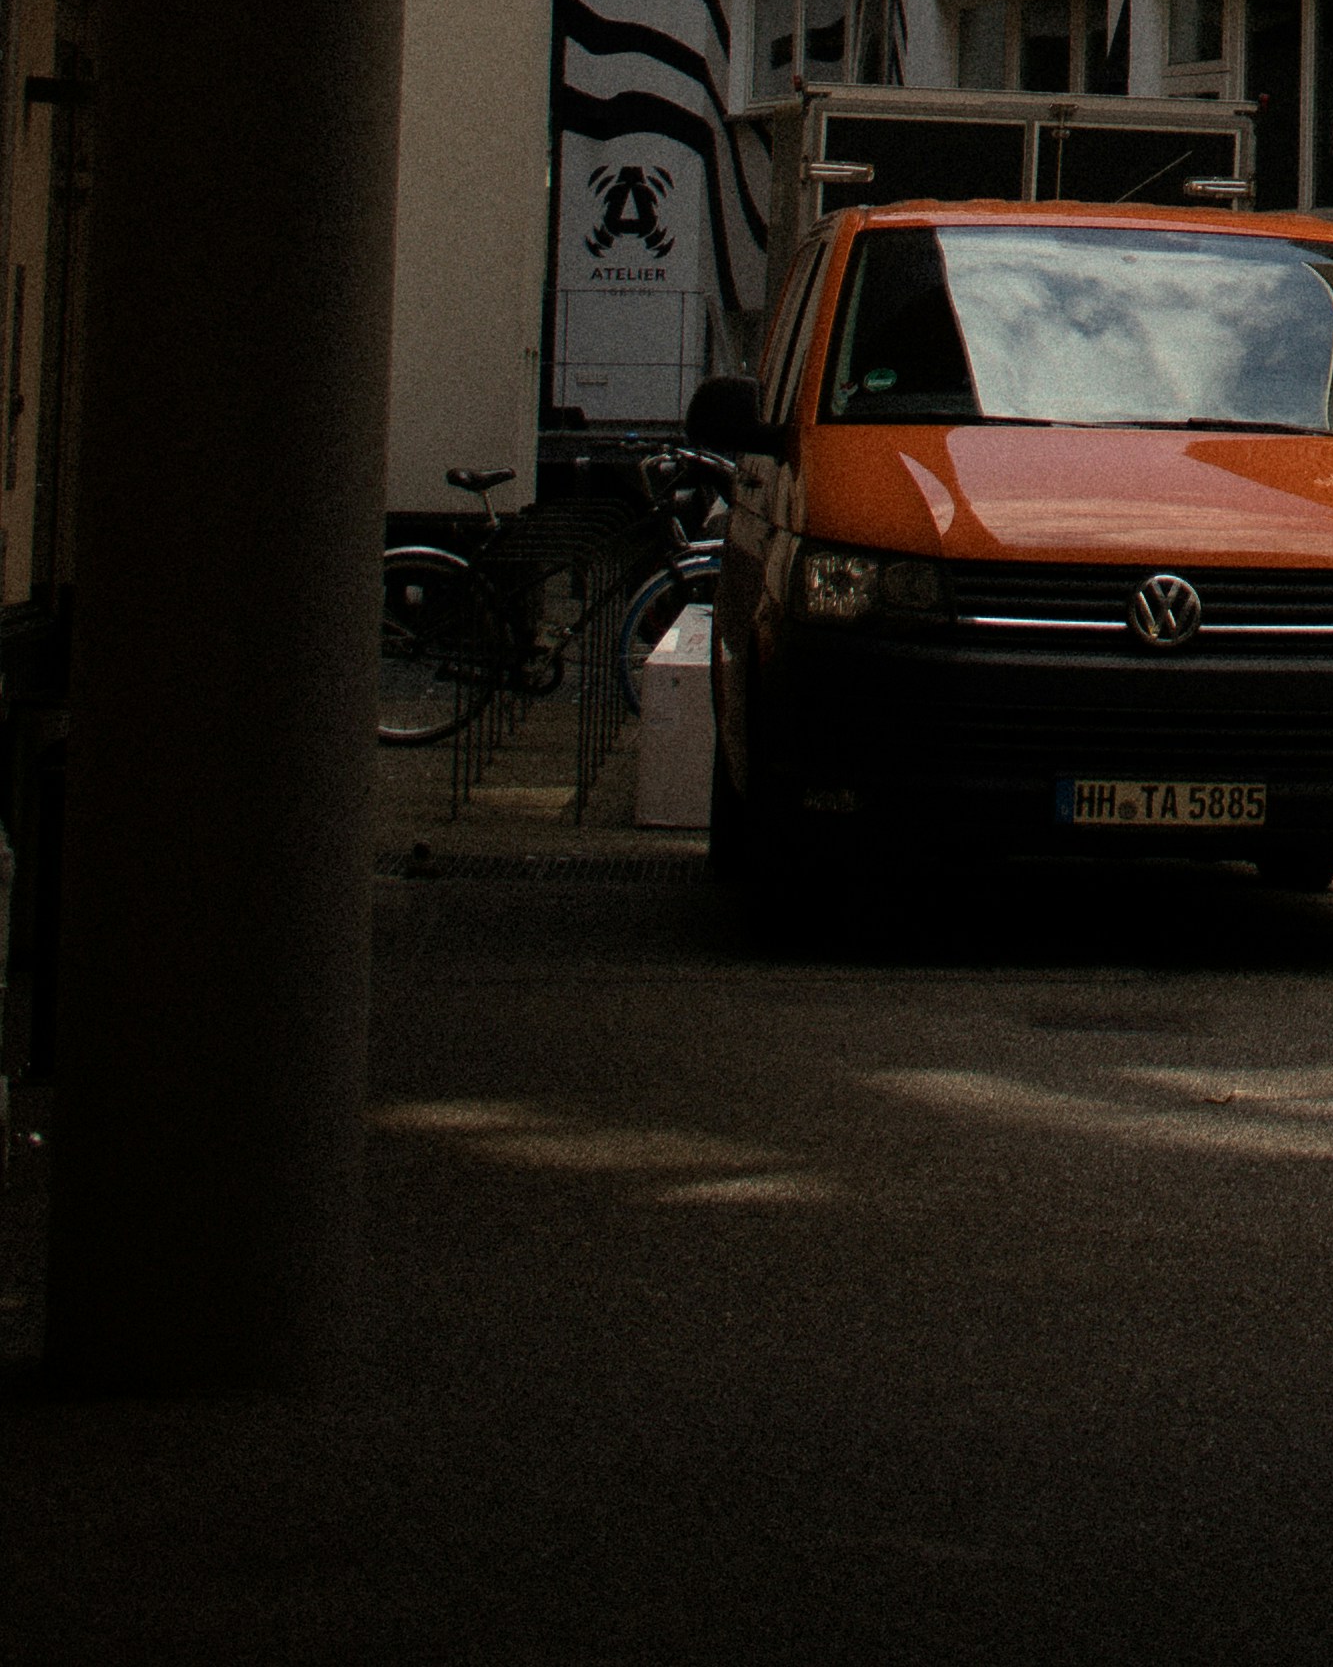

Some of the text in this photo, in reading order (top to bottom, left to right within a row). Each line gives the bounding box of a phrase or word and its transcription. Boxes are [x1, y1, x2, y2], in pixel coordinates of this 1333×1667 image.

[591, 267, 666, 281] ATELIER
[1076, 784, 1116, 818] HH
[1141, 785, 1179, 818] TA
[1189, 786, 1265, 819] 5885
